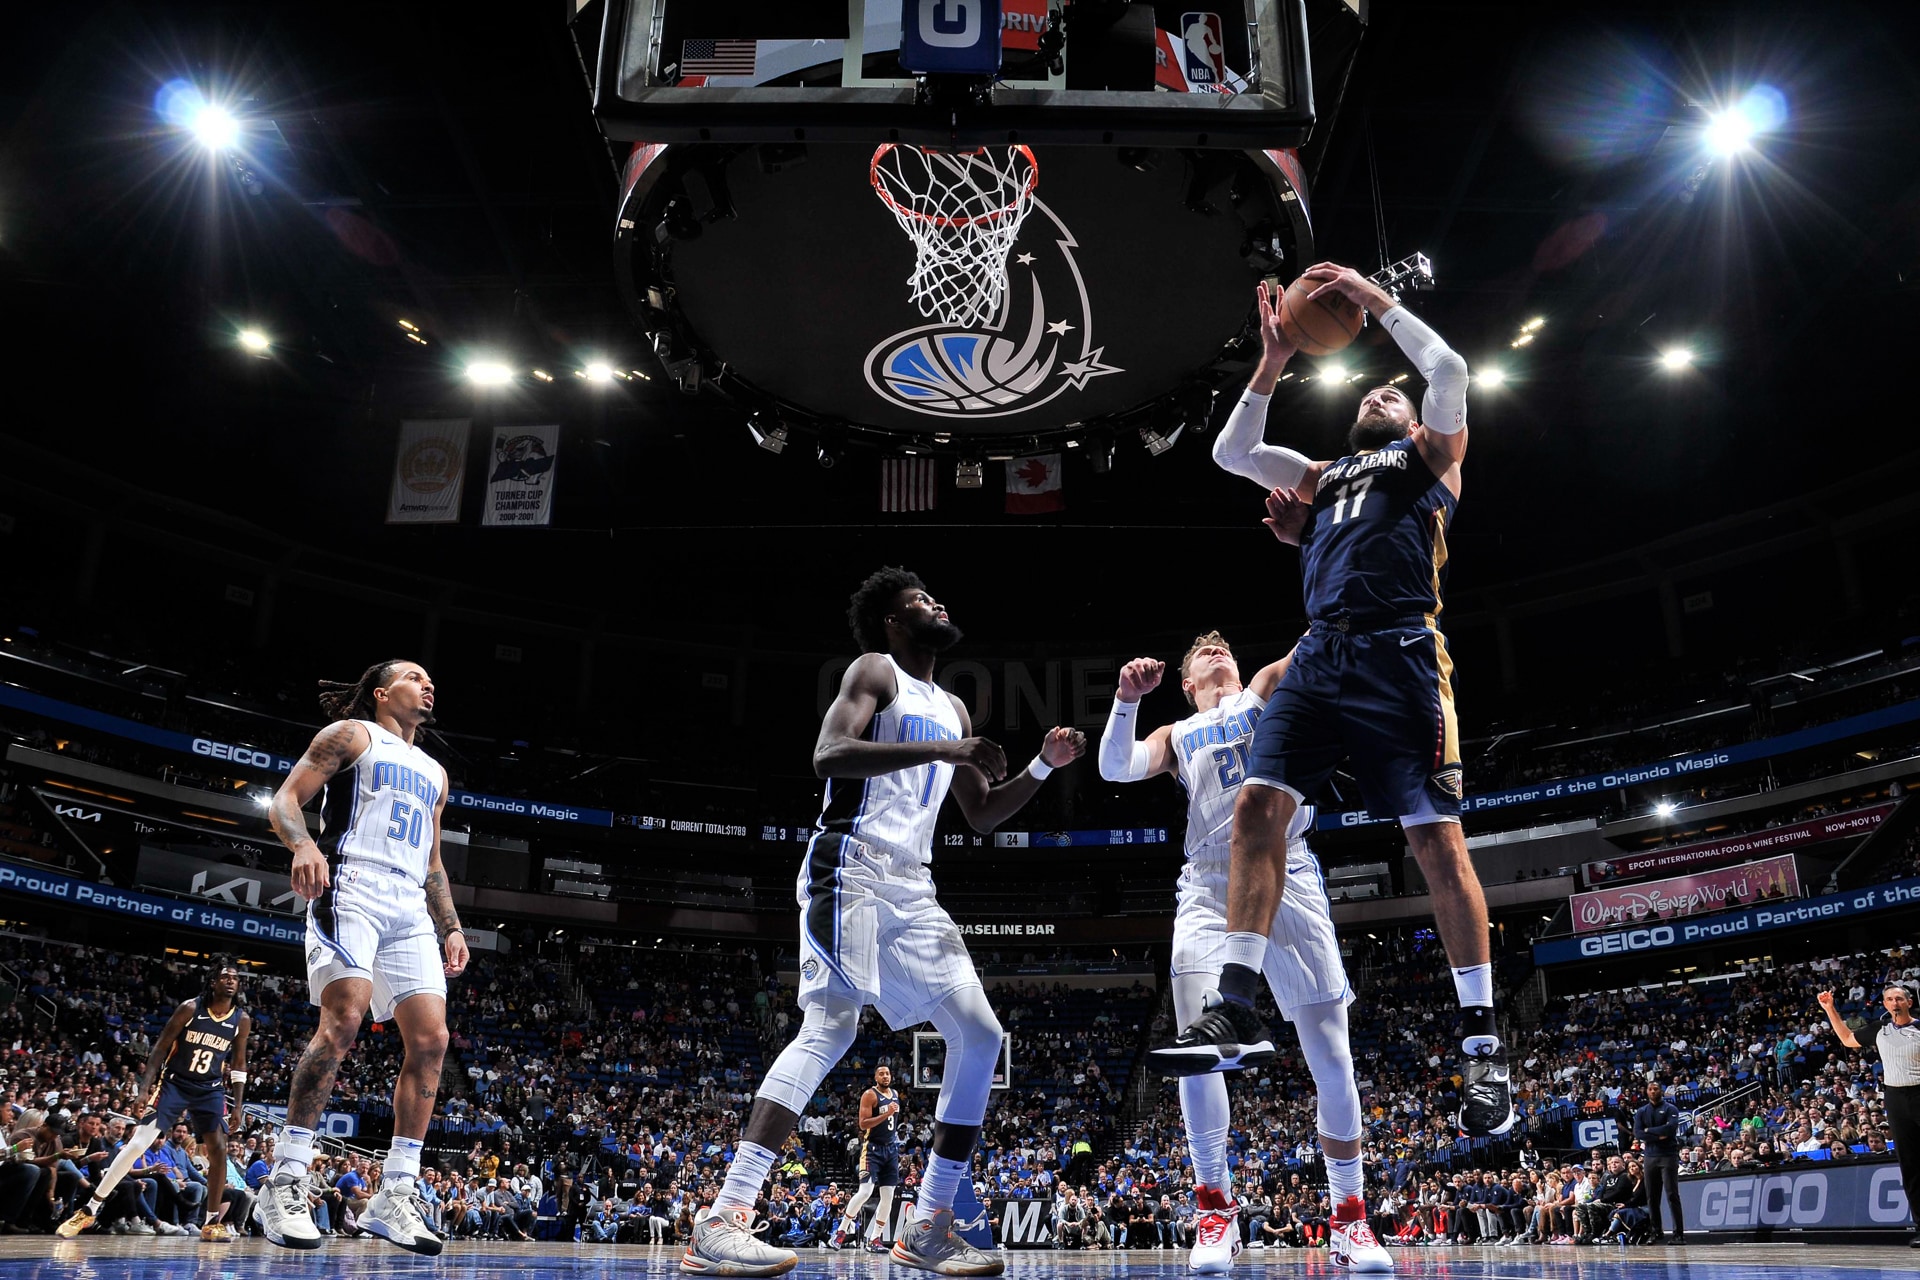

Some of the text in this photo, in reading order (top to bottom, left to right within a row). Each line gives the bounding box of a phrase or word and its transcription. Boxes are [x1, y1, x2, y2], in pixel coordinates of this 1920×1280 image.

[1191, 67, 1211, 81] NBA
[495, 490, 543, 500] TURNER CUP
[1332, 475, 1374, 525] 17
[399, 503, 429, 512] Amway
[495, 500, 540, 511] CHAMPIONS
[499, 512, 535, 521] 2000-2001
[192, 738, 271, 769] GEICO
[460, 795, 525, 813] Orlando
[531, 804, 579, 821] Magic
[920, 763, 937, 808] 1
[1476, 790, 1540, 809] Partner
[1546, 785, 1562, 796] of
[1568, 780, 1597, 792] the
[1603, 766, 1670, 787] Orlando
[1676, 753, 1729, 773] Magic
[55, 804, 102, 823] KIA
[1871, 815, 1881, 823] 18
[387, 800, 422, 848] 50
[671, 820, 703, 833] CURRENT
[762, 833, 777, 841] FOULS
[763, 826, 776, 834] TEAM
[779, 829, 787, 841] 3
[944, 834, 982, 847] 1:22 1st
[1006, 834, 1018, 846] 24
[1109, 835, 1157, 845] FOULS OUTS
[1126, 831, 1133, 843] 3
[1143, 828, 1156, 836] TIME
[1158, 830, 1166, 842] 6
[1628, 830, 1812, 871] EPCOT INTERNATIONAL FOOD & WINE FESTIVAL
[0, 867, 69, 897] Proud
[76, 885, 164, 917] Partner
[171, 907, 194, 922] of
[200, 912, 235, 930] the
[1697, 878, 1749, 904] World
[1580, 886, 1920, 956] GEICO Proud Partner of the
[957, 924, 1055, 935] BASELINE BAR
[185, 1030, 204, 1044] NEW
[188, 1048, 214, 1074] 13
[887, 1115, 895, 1131] 3
[1699, 1172, 1828, 1227] GEICO
